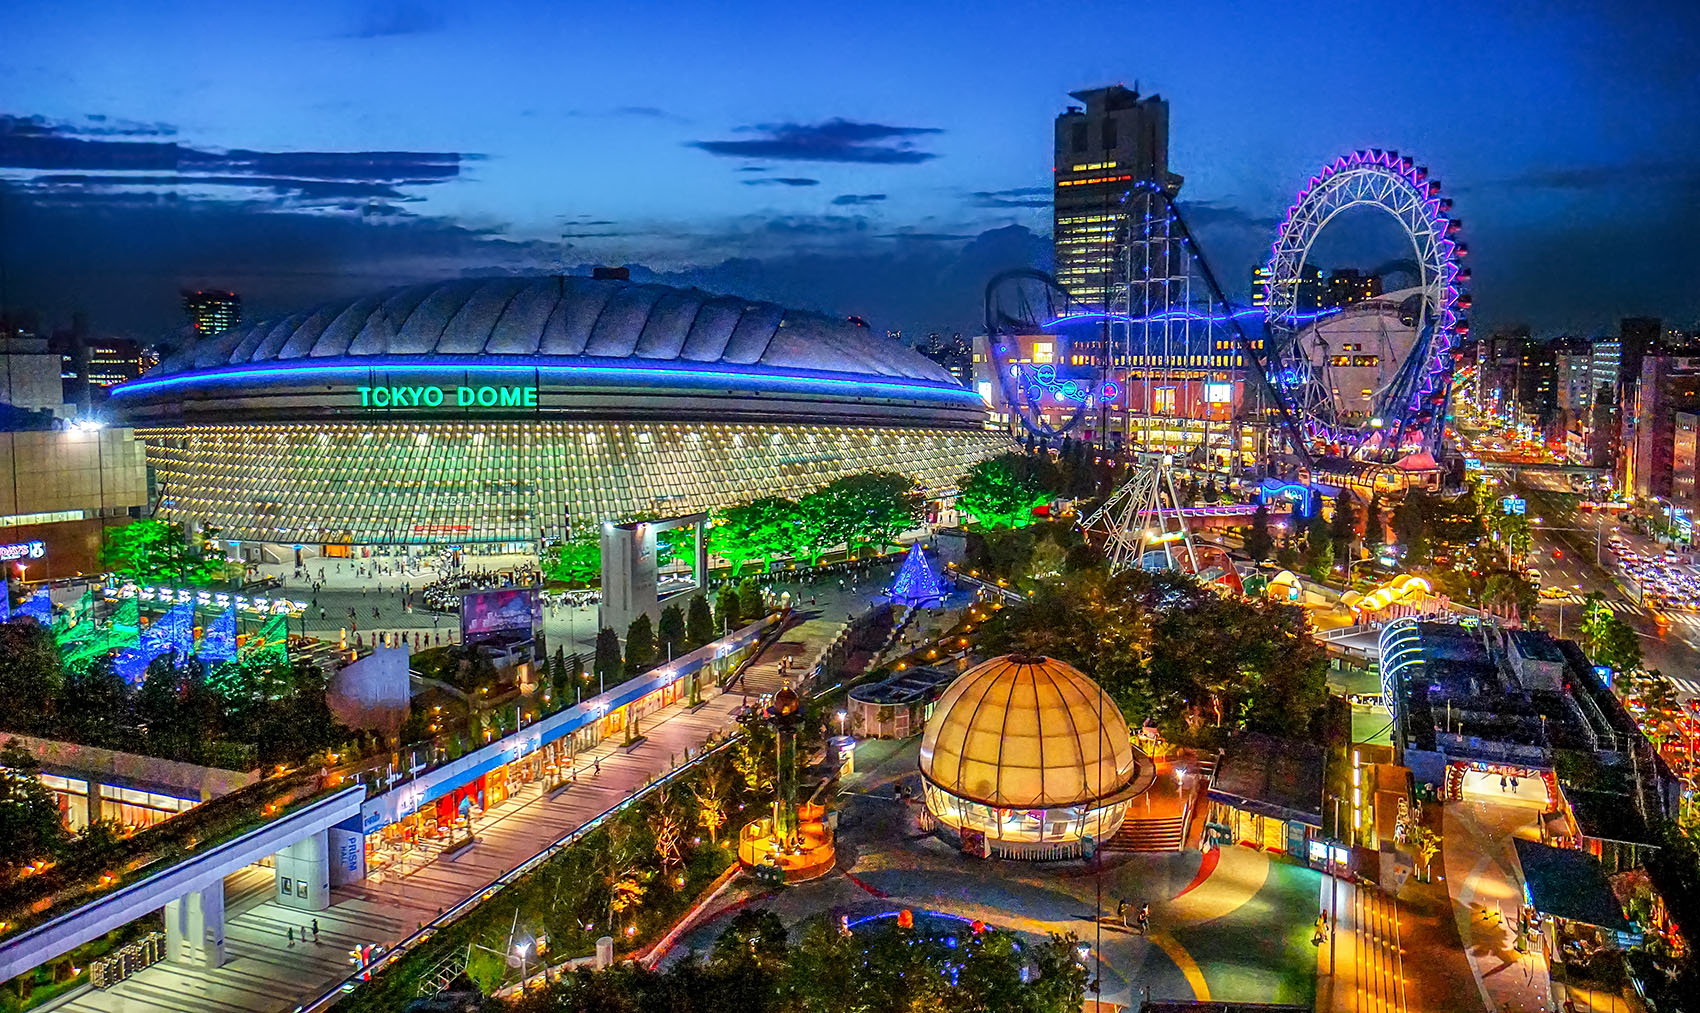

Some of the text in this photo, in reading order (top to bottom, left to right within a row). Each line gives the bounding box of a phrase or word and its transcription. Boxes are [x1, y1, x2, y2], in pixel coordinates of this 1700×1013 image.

[356, 386, 538, 407] TOKYO DOME
[347, 836, 358, 872] PRISM
